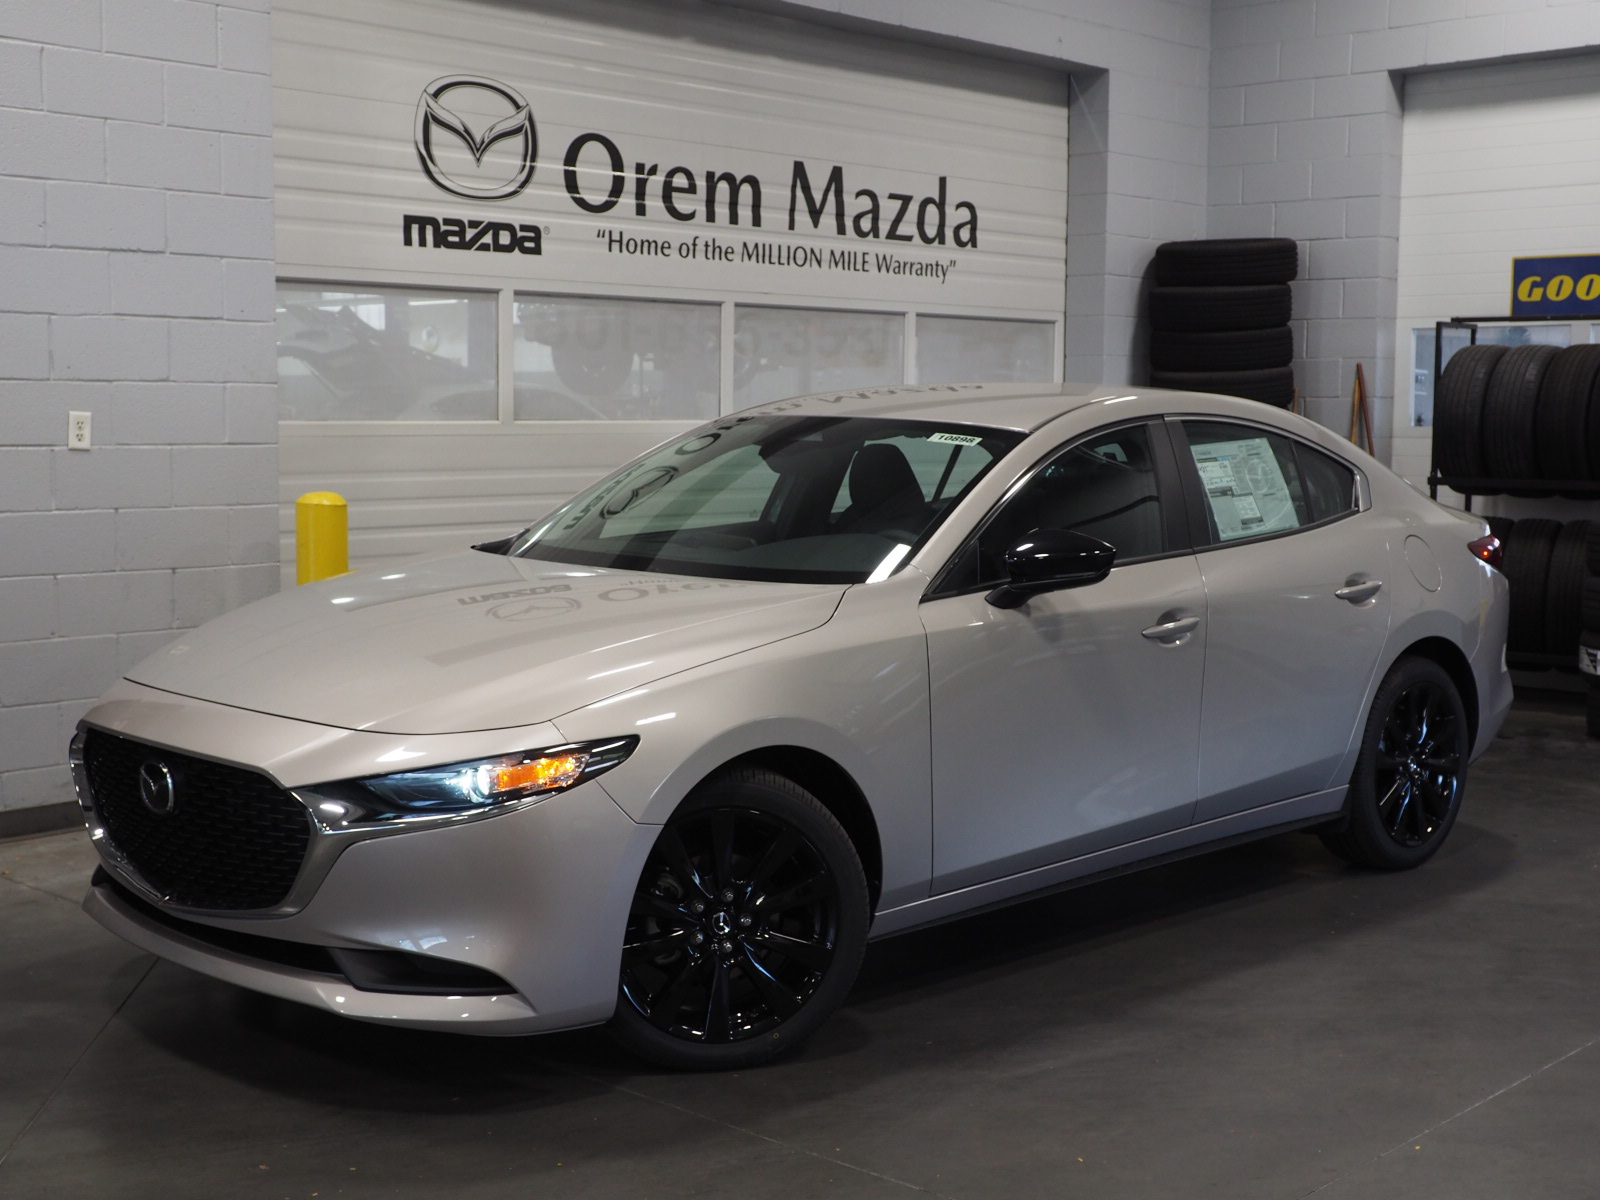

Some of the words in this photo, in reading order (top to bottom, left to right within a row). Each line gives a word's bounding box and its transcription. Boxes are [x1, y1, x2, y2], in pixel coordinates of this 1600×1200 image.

[563, 132, 762, 228] Orem
[788, 160, 978, 249] Mazda
[403, 214, 542, 256] mazda
[678, 236, 699, 259] of
[704, 238, 735, 262] the
[741, 241, 822, 268] MILLION
[828, 249, 870, 273] MILE
[938, 434, 976, 443] 10898
